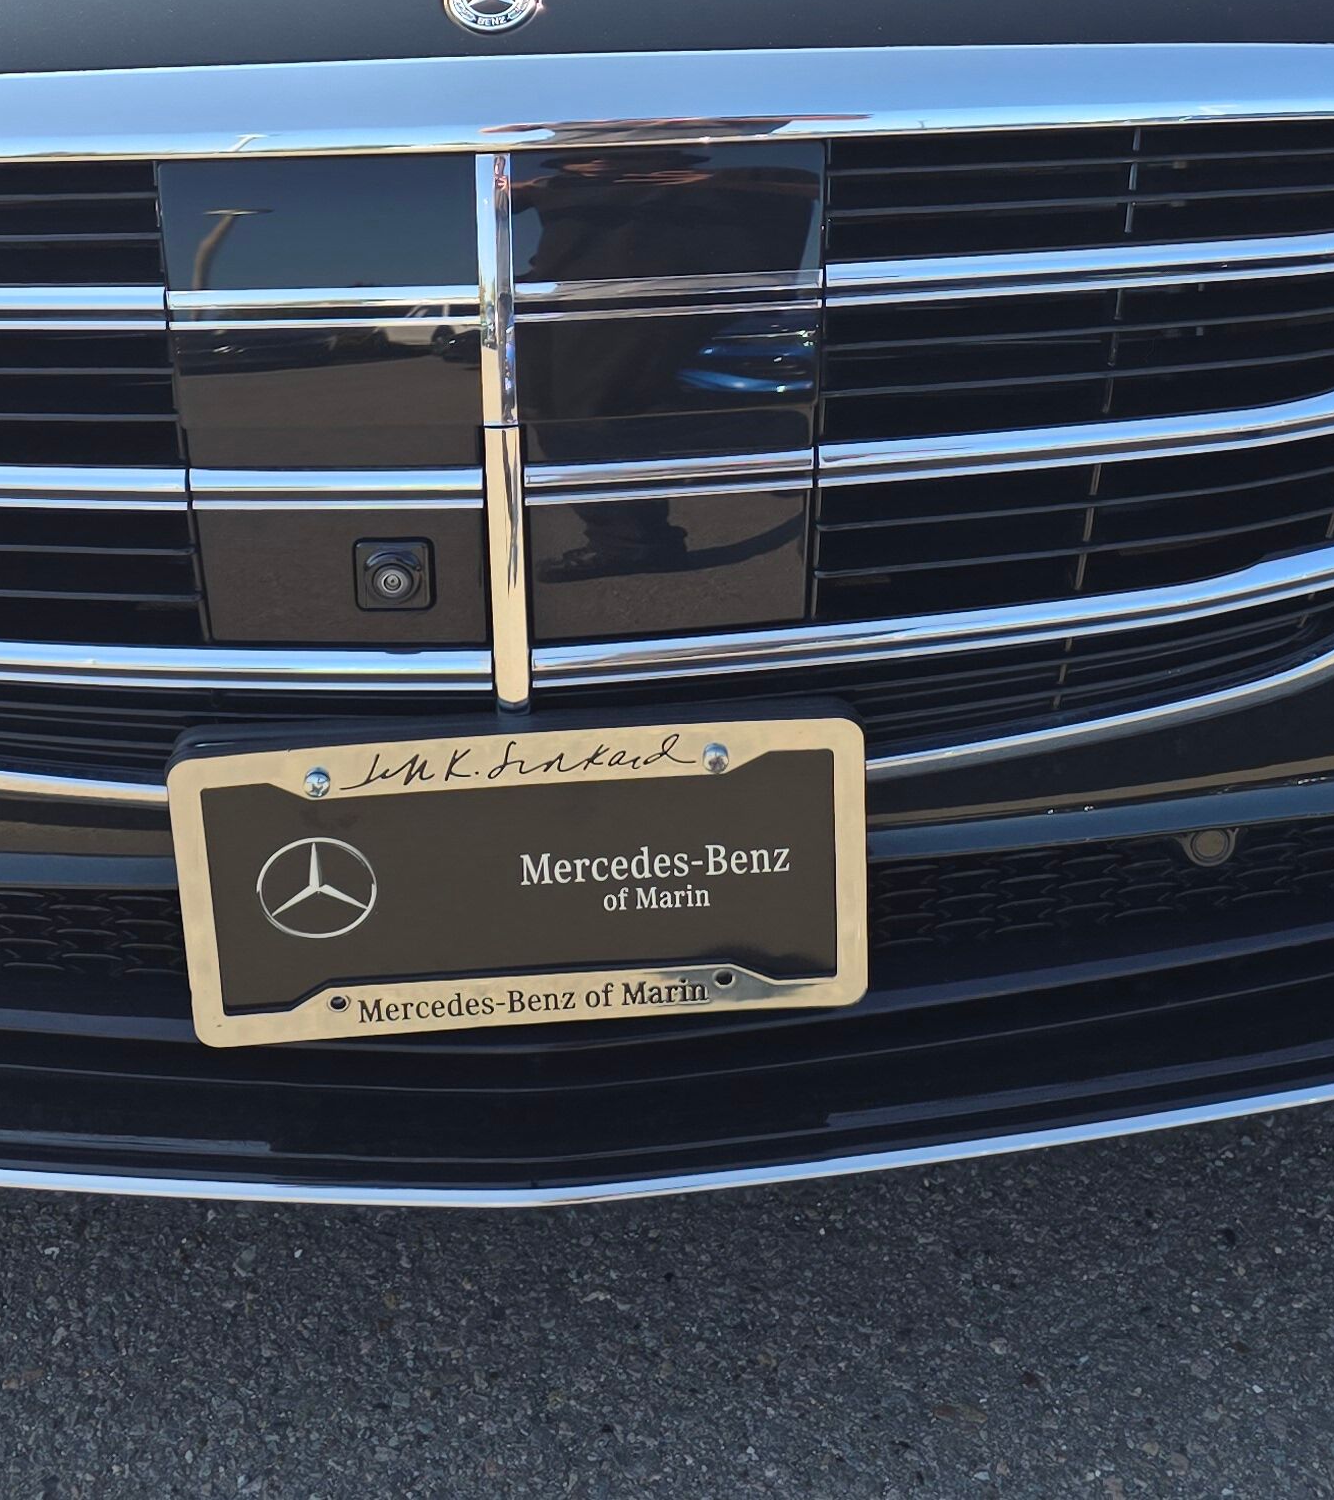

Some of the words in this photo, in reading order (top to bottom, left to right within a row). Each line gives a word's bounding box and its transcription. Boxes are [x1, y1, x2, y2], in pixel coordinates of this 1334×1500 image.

[477, 15, 508, 26] BENZ
[519, 844, 791, 886] Mercedes-Benz
[603, 886, 629, 912] of
[635, 884, 711, 910] Marin
[357, 990, 577, 1024] Mercedes-Benz
[585, 983, 614, 1008] of
[621, 978, 710, 1006] Marin
